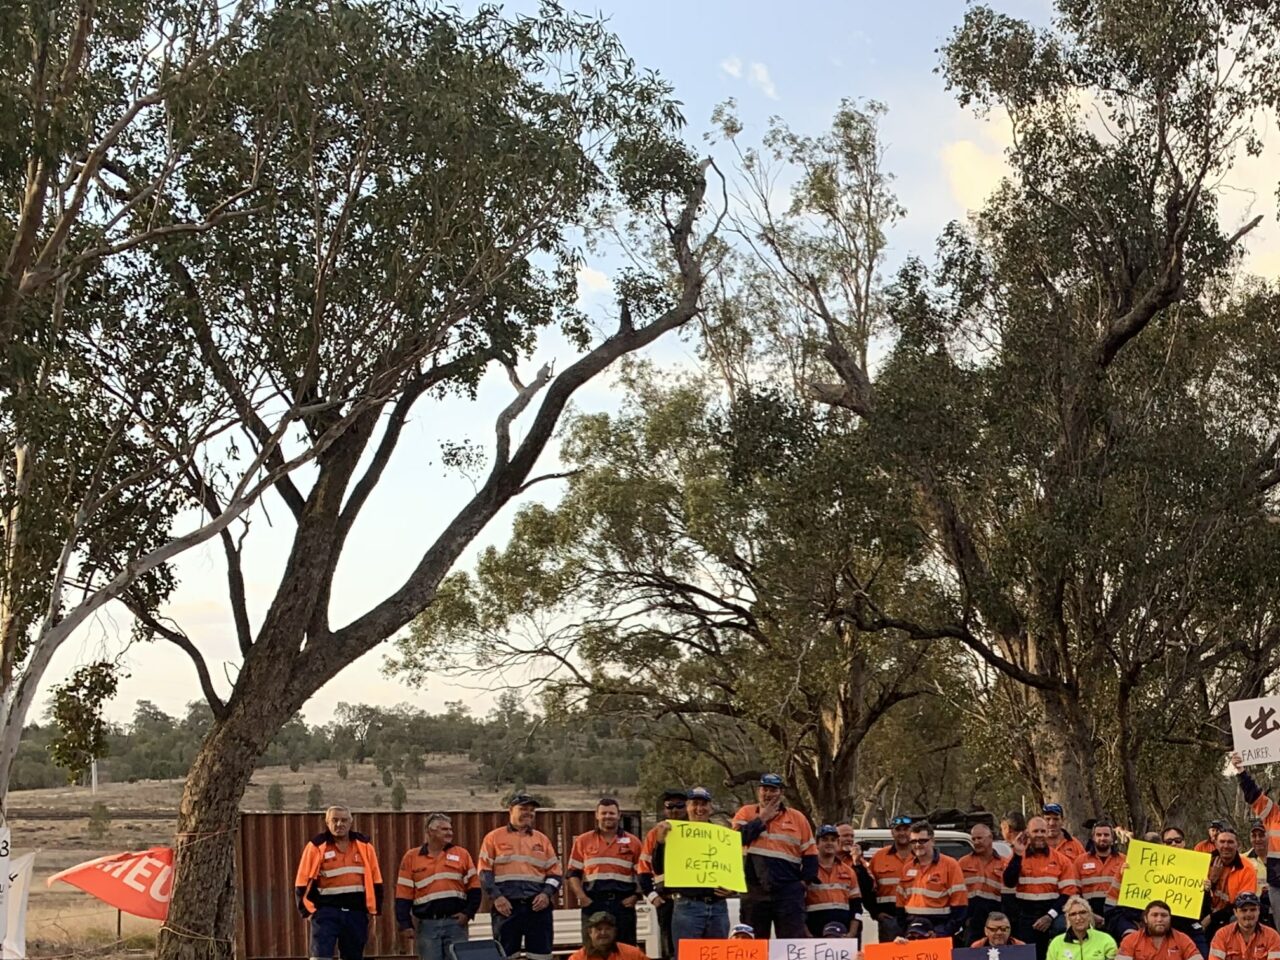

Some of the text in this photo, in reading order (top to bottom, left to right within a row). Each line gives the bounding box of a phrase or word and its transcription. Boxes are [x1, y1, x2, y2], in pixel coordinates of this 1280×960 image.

[1241, 747, 1271, 761] FAIRER
[677, 823, 712, 839] TRAIN
[1140, 847, 1176, 866] FAIR
[685, 858, 731, 873] RETAIN
[696, 871, 717, 884] US
[1125, 883, 1193, 909] FAIR PAY
[726, 945, 759, 960] FAIR
[786, 943, 806, 960] BE
